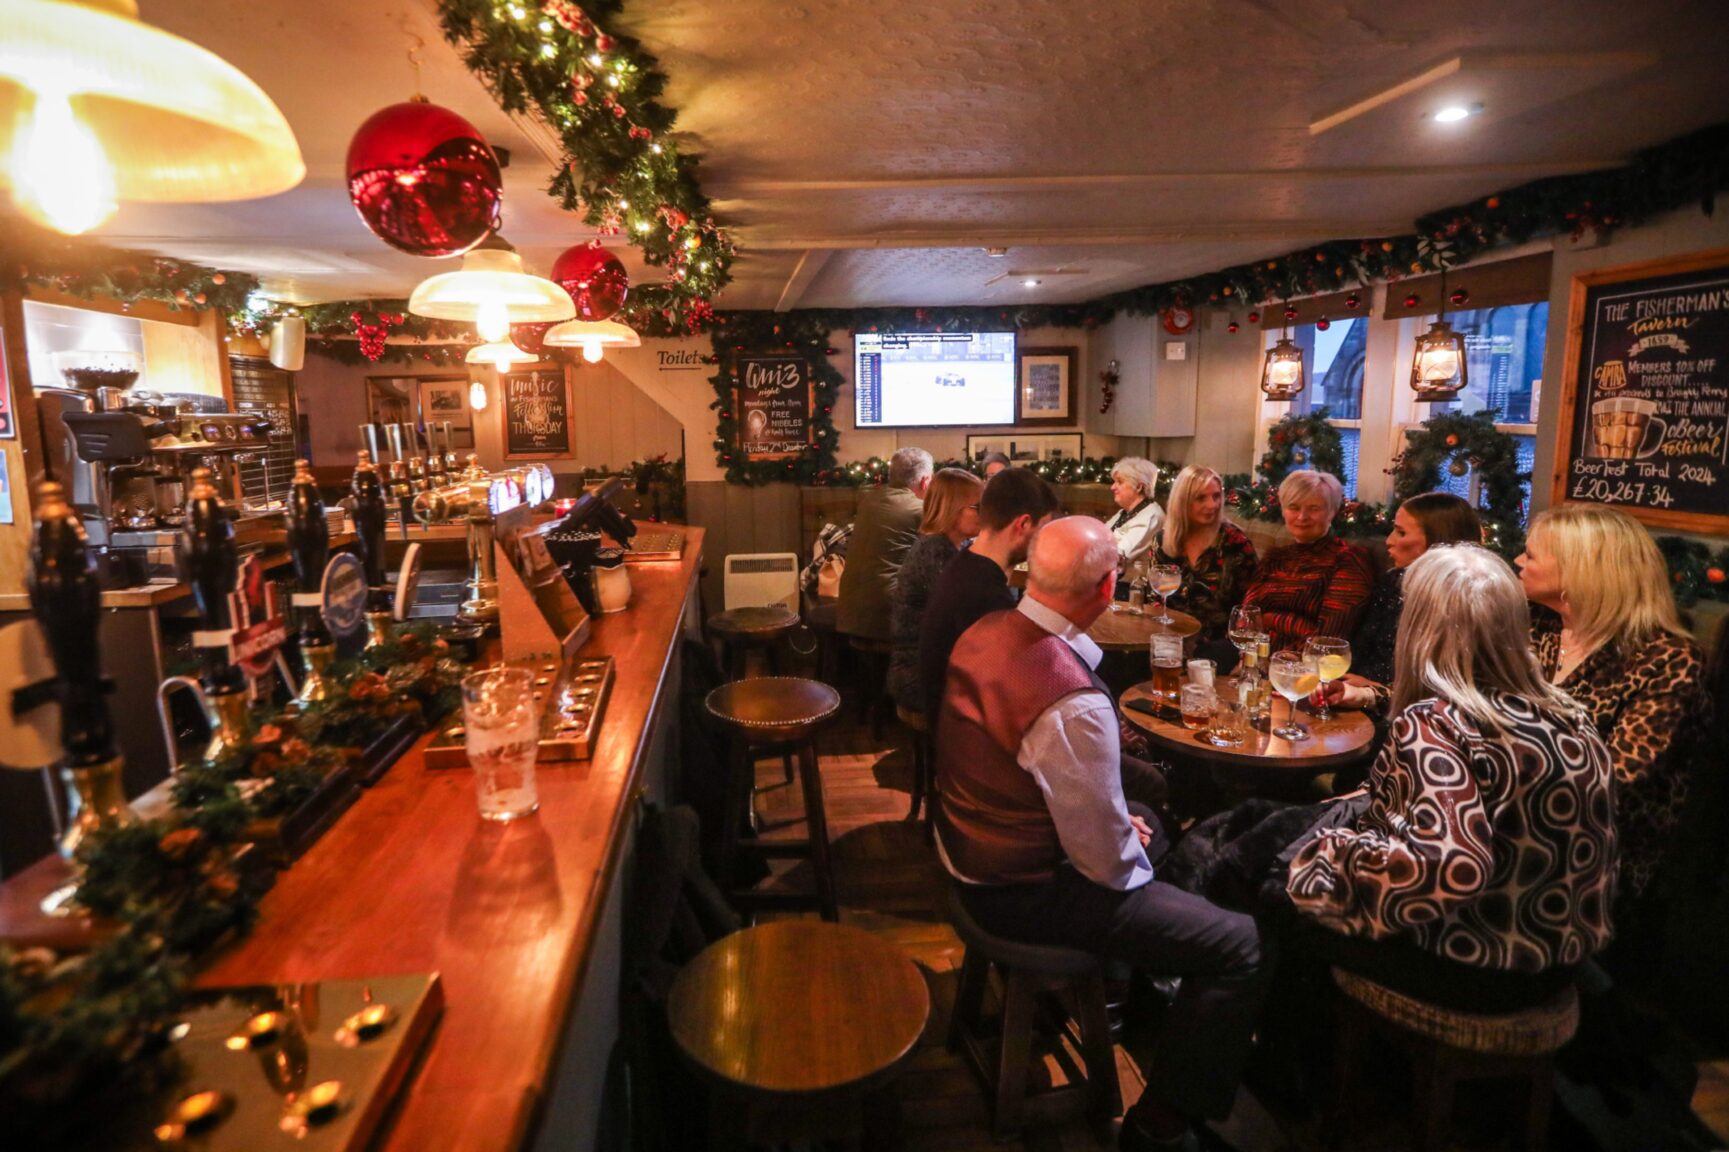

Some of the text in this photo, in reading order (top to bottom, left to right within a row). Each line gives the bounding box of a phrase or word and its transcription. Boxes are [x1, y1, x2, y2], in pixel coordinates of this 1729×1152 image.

[1605, 303, 1629, 321] THE
[1627, 316, 1697, 335] Tavern
[1697, 359, 1716, 373] OFF
[771, 410, 791, 419] FREE
[1674, 400, 1689, 416] THE
[1691, 400, 1726, 416] ANNUAL
[511, 421, 563, 436] THURSDAY
[1667, 418, 1723, 439] Beer
[1660, 436, 1721, 457] Festival
[1634, 461, 1670, 479] Total
[1678, 464, 1716, 486] 2024
